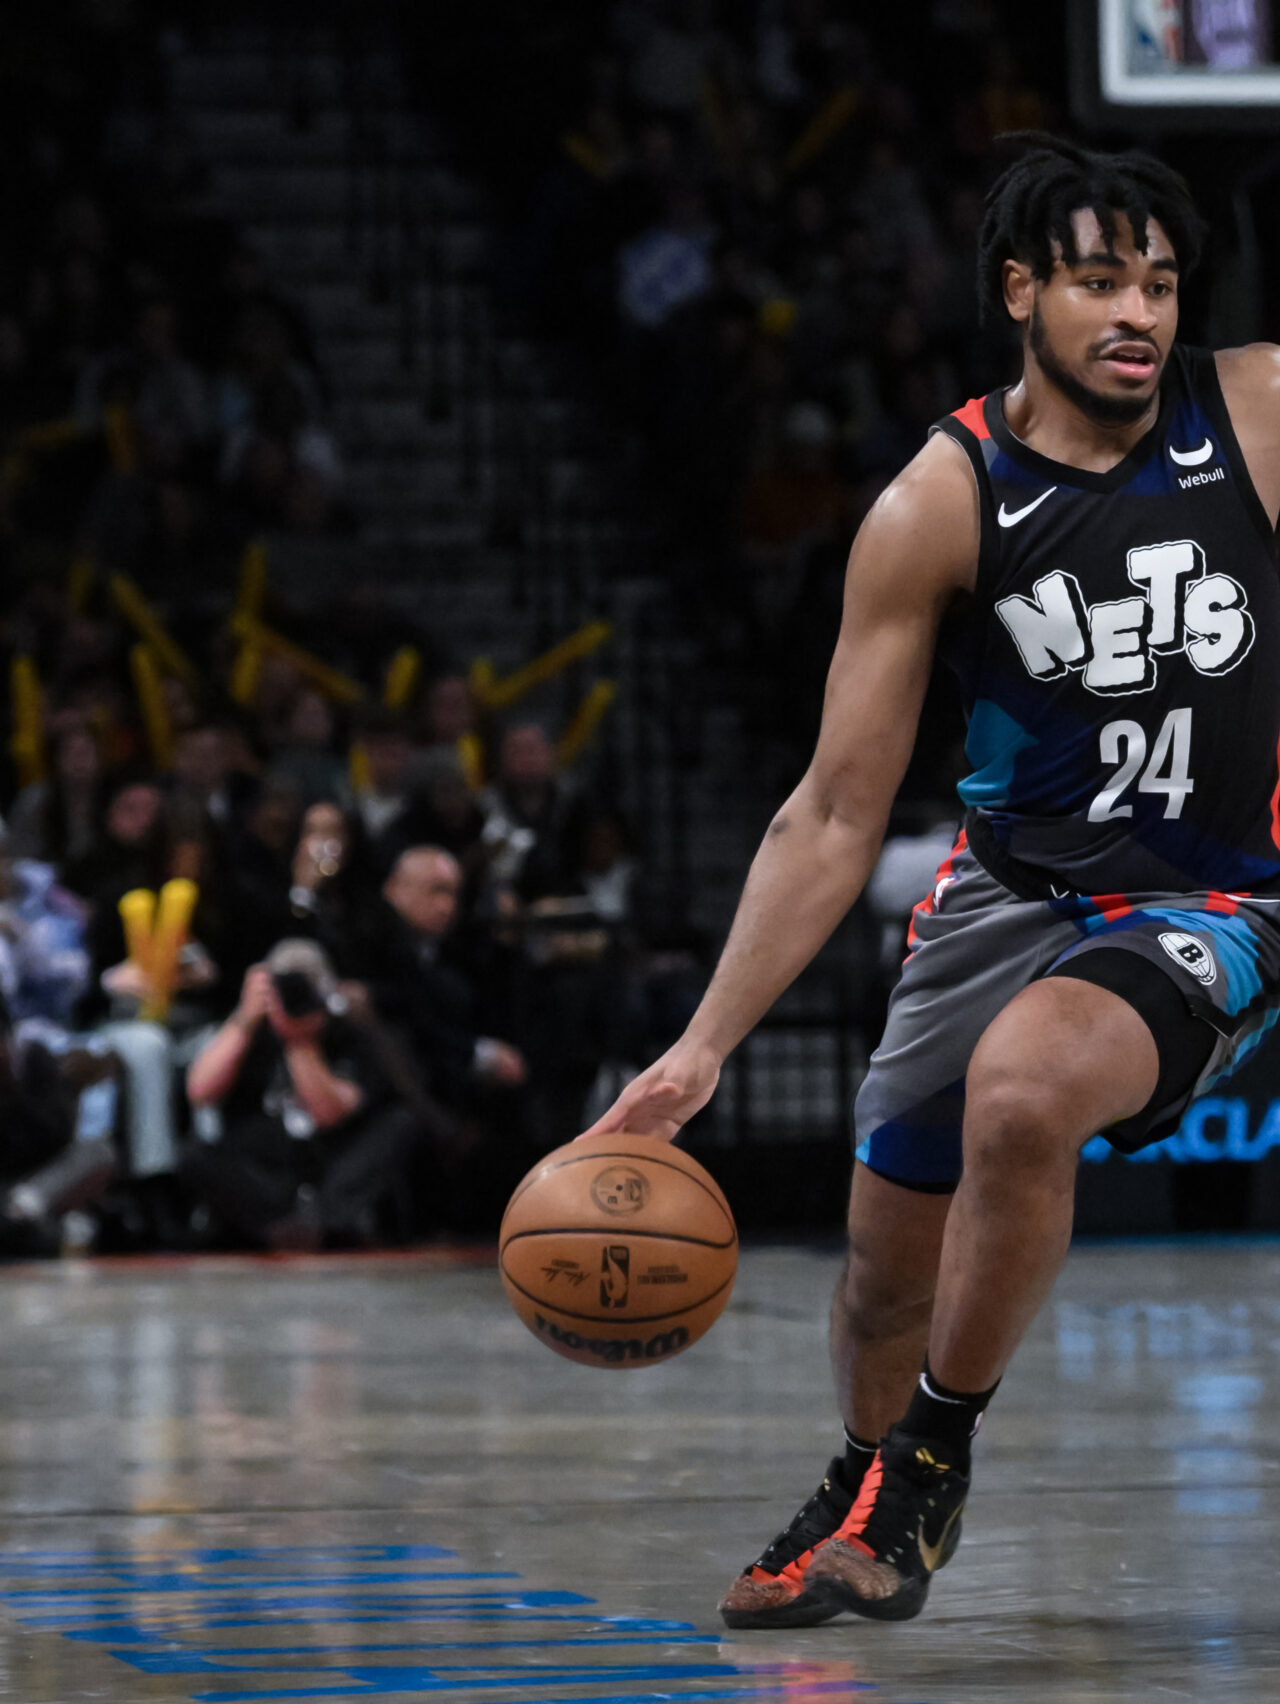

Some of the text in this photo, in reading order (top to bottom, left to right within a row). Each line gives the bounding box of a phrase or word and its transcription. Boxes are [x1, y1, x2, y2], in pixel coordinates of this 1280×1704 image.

[1178, 467, 1225, 489] Webull
[995, 539, 1256, 697] NETS
[1087, 707, 1194, 823] 24
